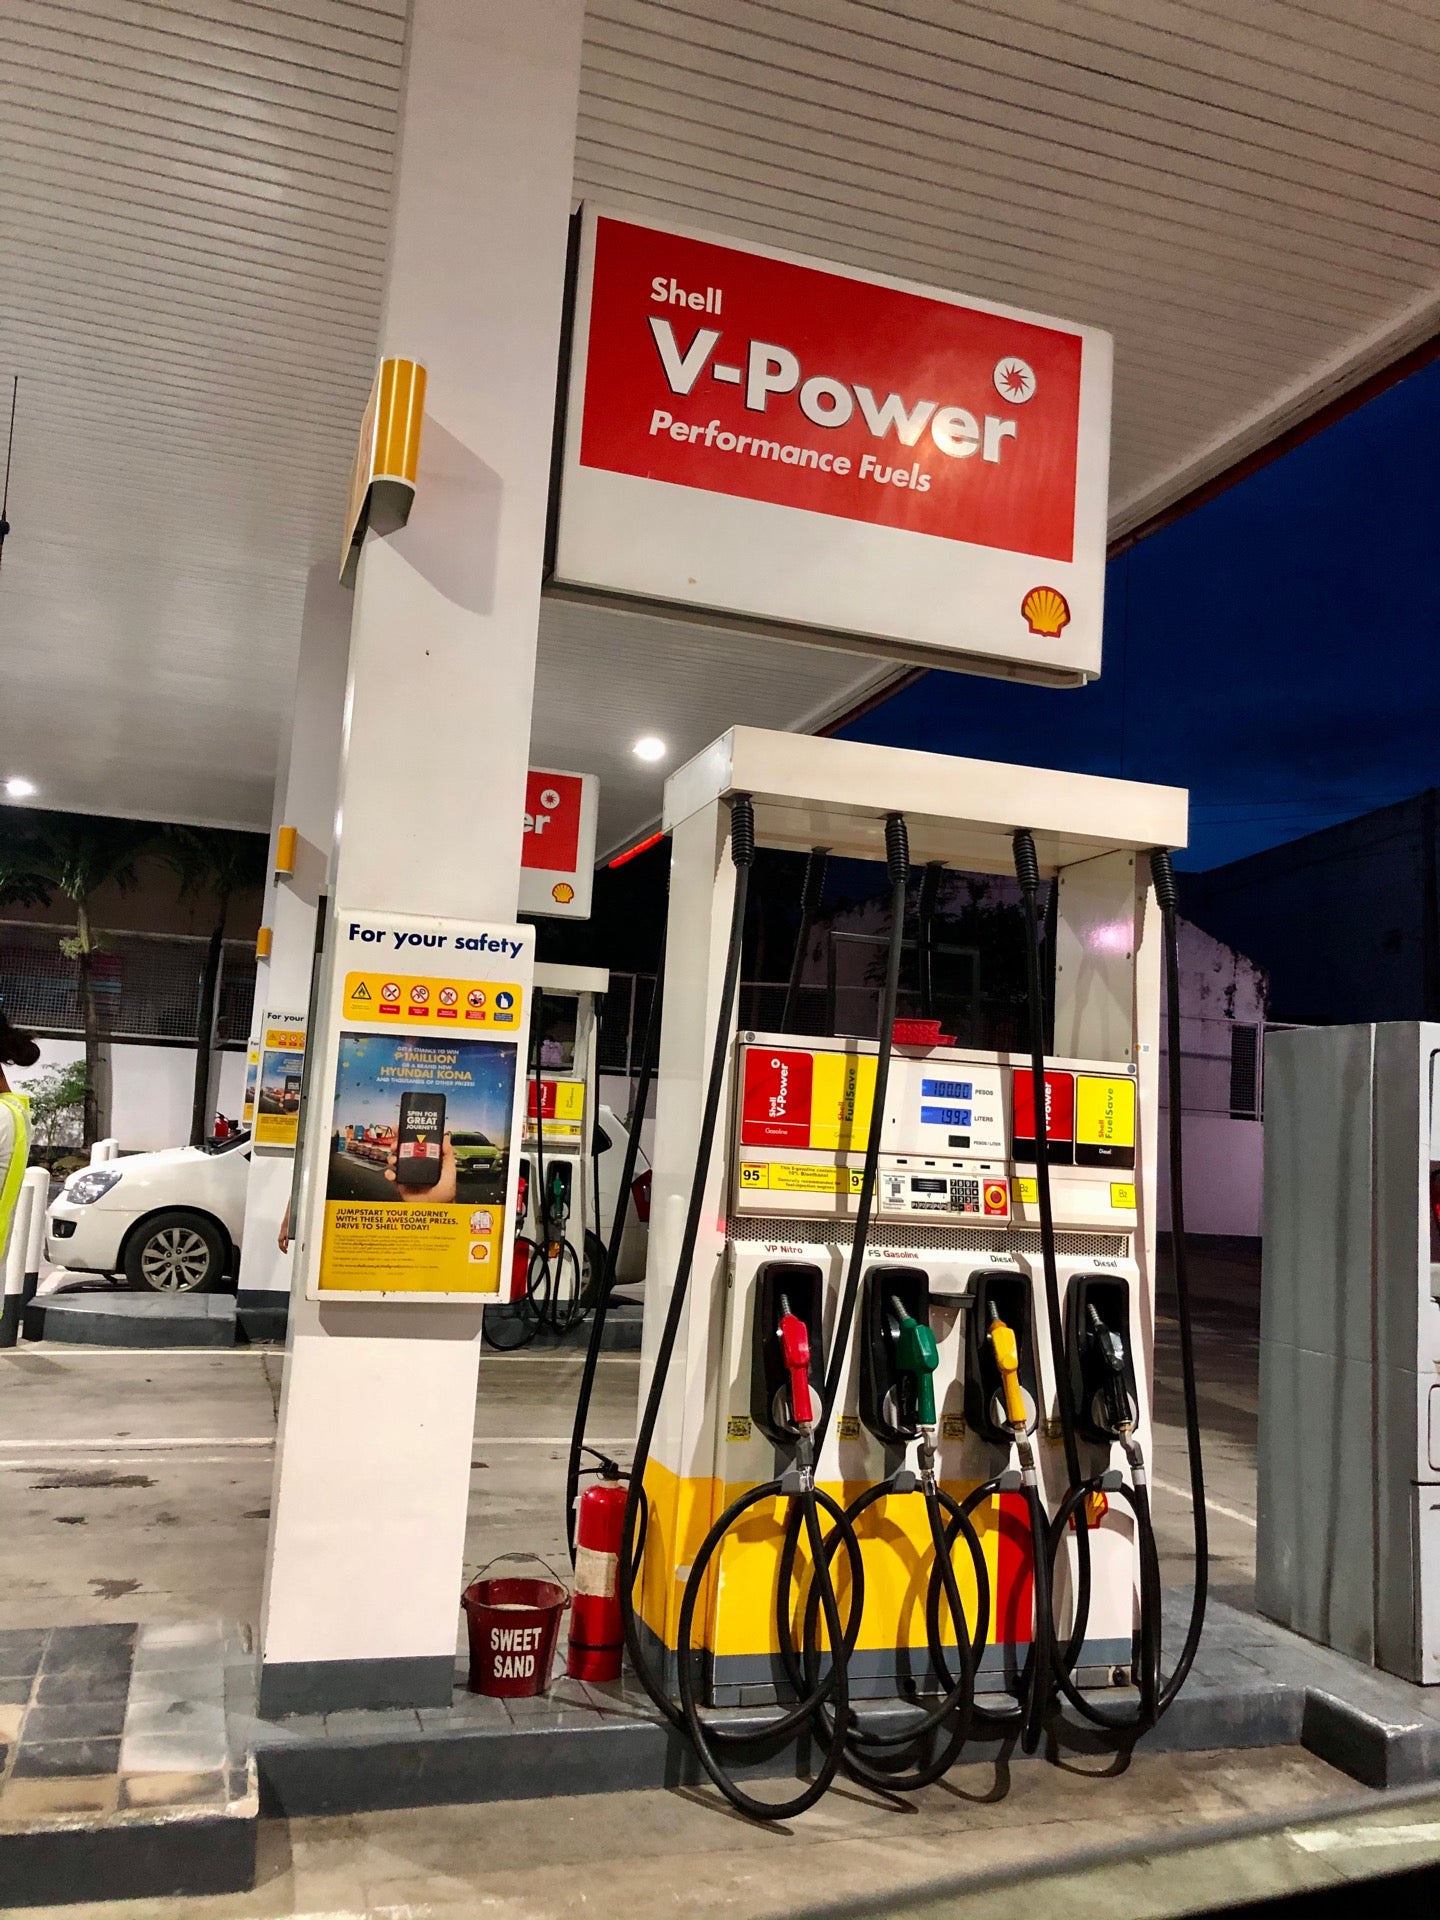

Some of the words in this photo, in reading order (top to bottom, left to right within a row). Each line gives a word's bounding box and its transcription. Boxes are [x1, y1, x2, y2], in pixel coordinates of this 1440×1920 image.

[650, 277, 722, 314] Shell
[647, 315, 1017, 462] V-Power
[649, 410, 851, 476] Performance
[858, 455, 932, 492] Fuels
[349, 923, 386, 942] For
[394, 932, 447, 950] your
[454, 933, 524, 959] safety
[268, 1012, 281, 1020] For
[284, 1014, 304, 1022] your
[381, 1067, 433, 1078] HYUNDAI
[437, 1070, 472, 1080] KONA
[776, 1063, 788, 1116] V-Power
[845, 1068, 855, 1122] FuelSave
[942, 1109, 968, 1125] 1.992
[1105, 1088, 1114, 1139] FuelSave
[743, 1170, 759, 1180] 95
[780, 1246, 803, 1254] Nitro
[884, 1250, 919, 1259] Gasoline
[490, 1627, 542, 1651] SWEET
[493, 1655, 535, 1678] SAND
